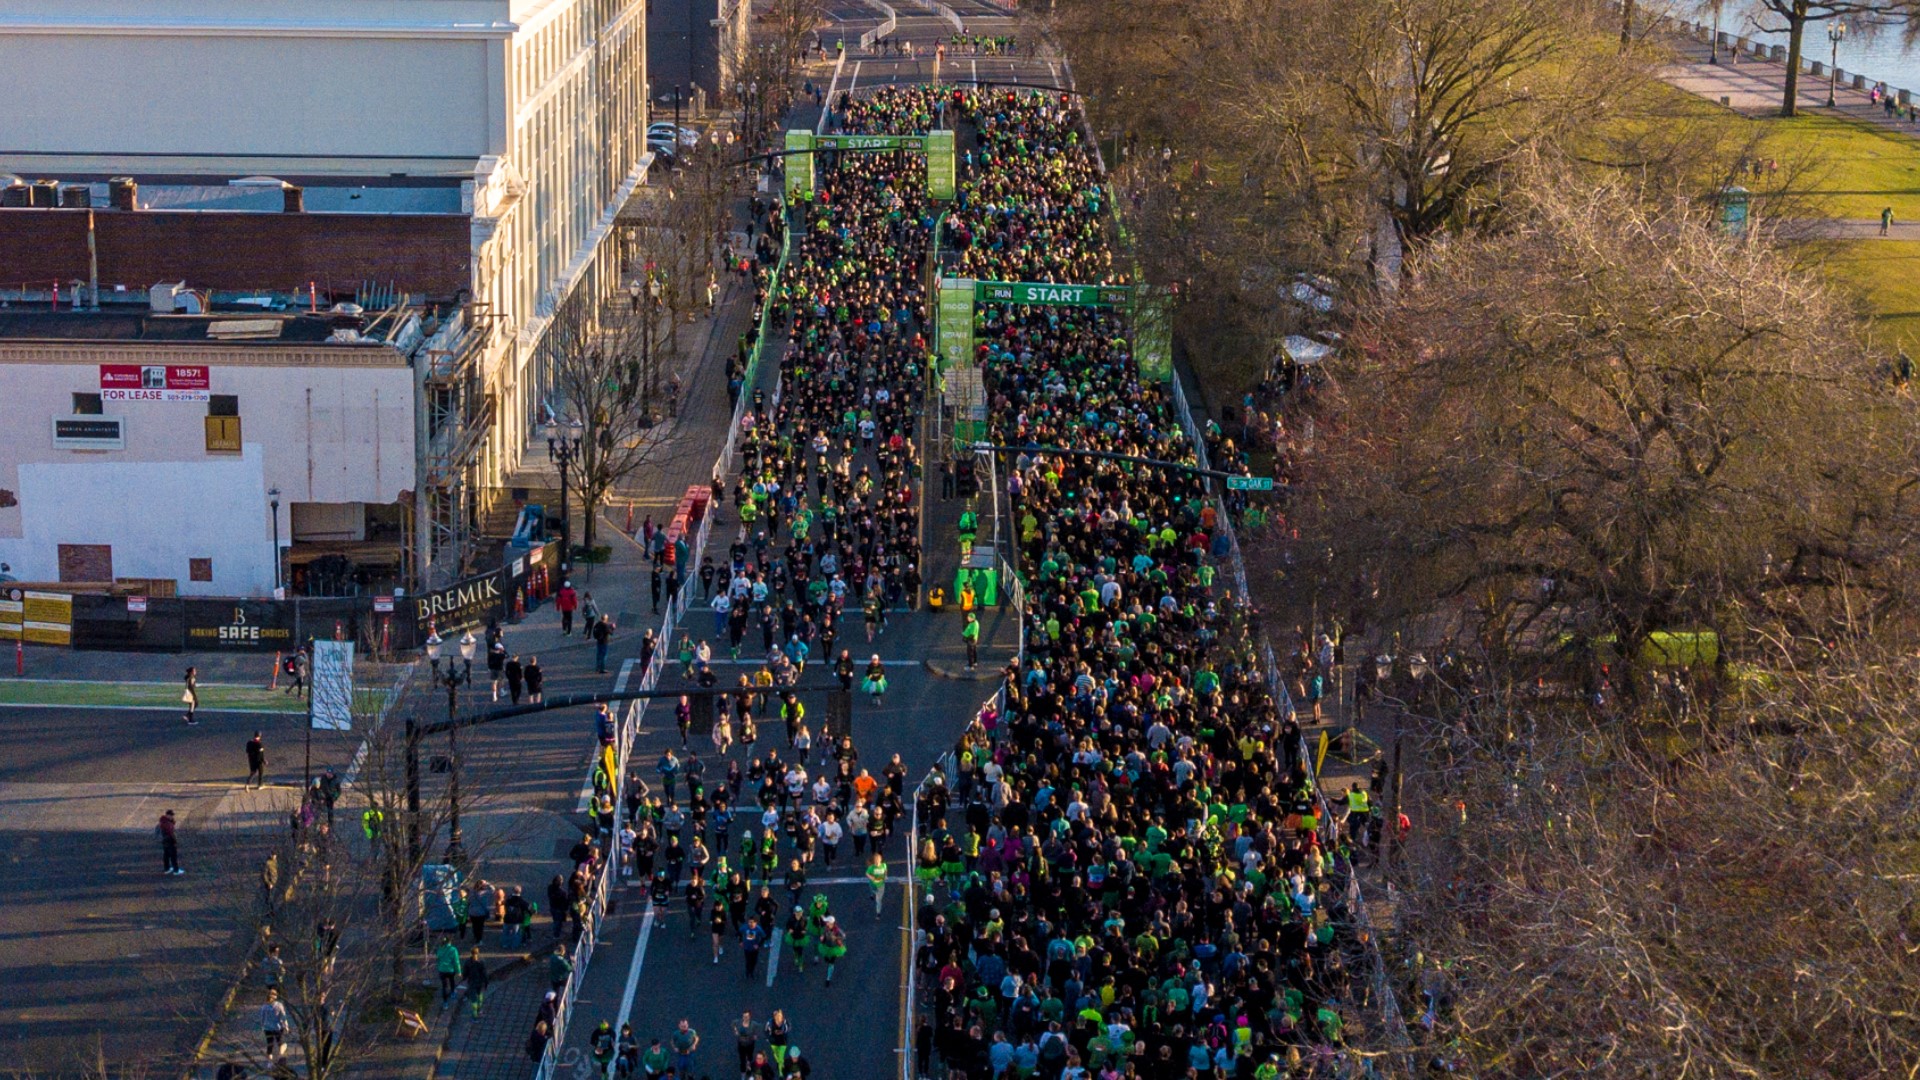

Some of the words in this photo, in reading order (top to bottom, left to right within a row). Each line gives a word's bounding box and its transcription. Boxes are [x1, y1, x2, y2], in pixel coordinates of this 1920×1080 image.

[824, 140, 837, 148] RUN
[848, 139, 890, 149] START
[908, 141, 921, 149] RUN
[994, 289, 1012, 299] RUN
[1027, 287, 1083, 302] START
[1108, 293, 1126, 301] RUN
[103, 390, 125, 399] FOR
[128, 390, 162, 400] LEASE
[1249, 479, 1262, 489] OAK
[417, 576, 501, 621] BREMIK
[418, 598, 502, 631] CSTRUCTION
[218, 626, 260, 639] SAFE
